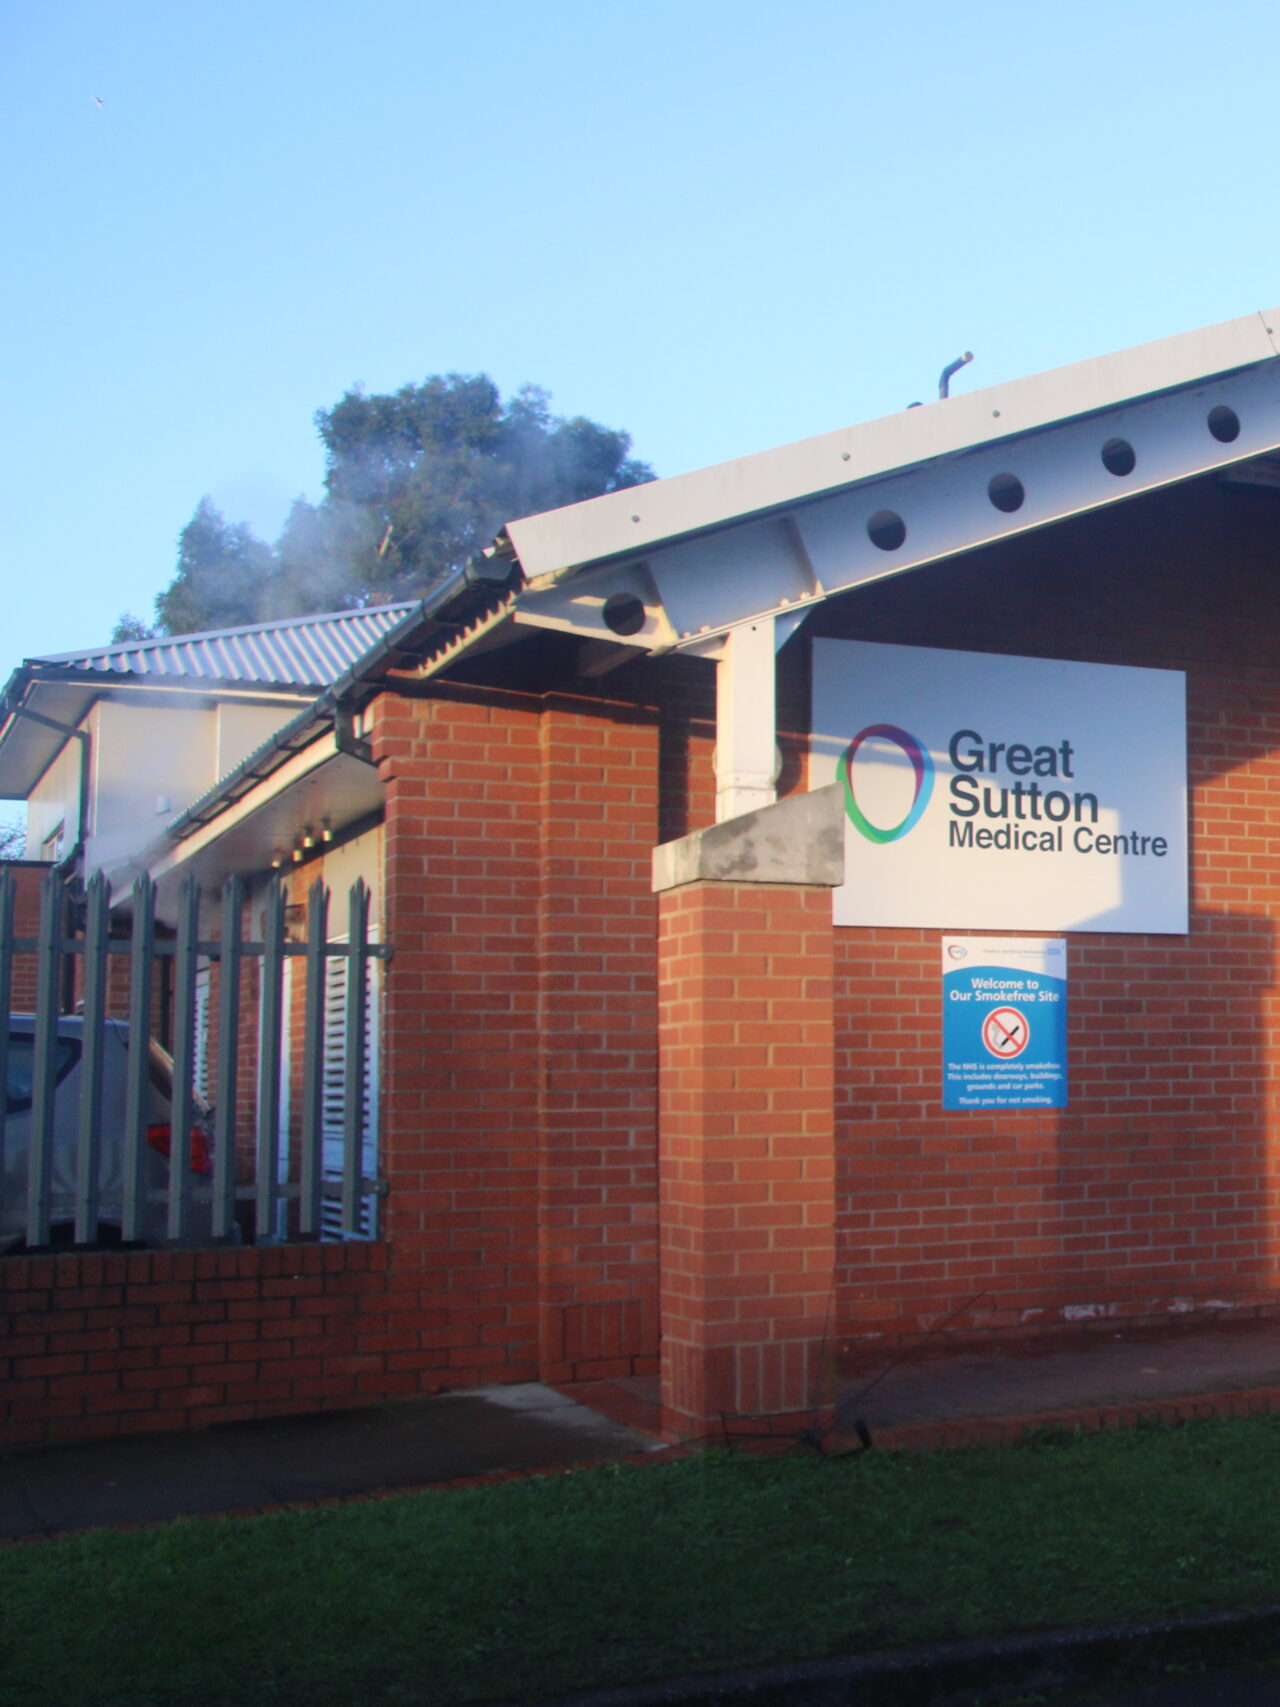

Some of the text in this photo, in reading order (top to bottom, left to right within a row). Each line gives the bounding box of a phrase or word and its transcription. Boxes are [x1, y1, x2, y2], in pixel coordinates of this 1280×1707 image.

[948, 728, 1074, 778] Great
[948, 774, 1099, 823] Sutton
[948, 820, 1168, 857] Medical Centre
[971, 978, 1039, 989] Welcome to
[950, 990, 1060, 1002] Our Smokefree Site
[979, 1062, 985, 1070] is
[986, 1062, 1024, 1072] completely
[963, 1072, 992, 1080] includes
[966, 1082, 996, 1092] grounds
[997, 1082, 1011, 1090] and
[1024, 1082, 1045, 1091] parks.
[958, 1096, 980, 1104] Thank
[981, 1098, 996, 1106] you
[996, 1096, 1008, 1104] for
[1022, 1096, 1053, 1106] smoking.
